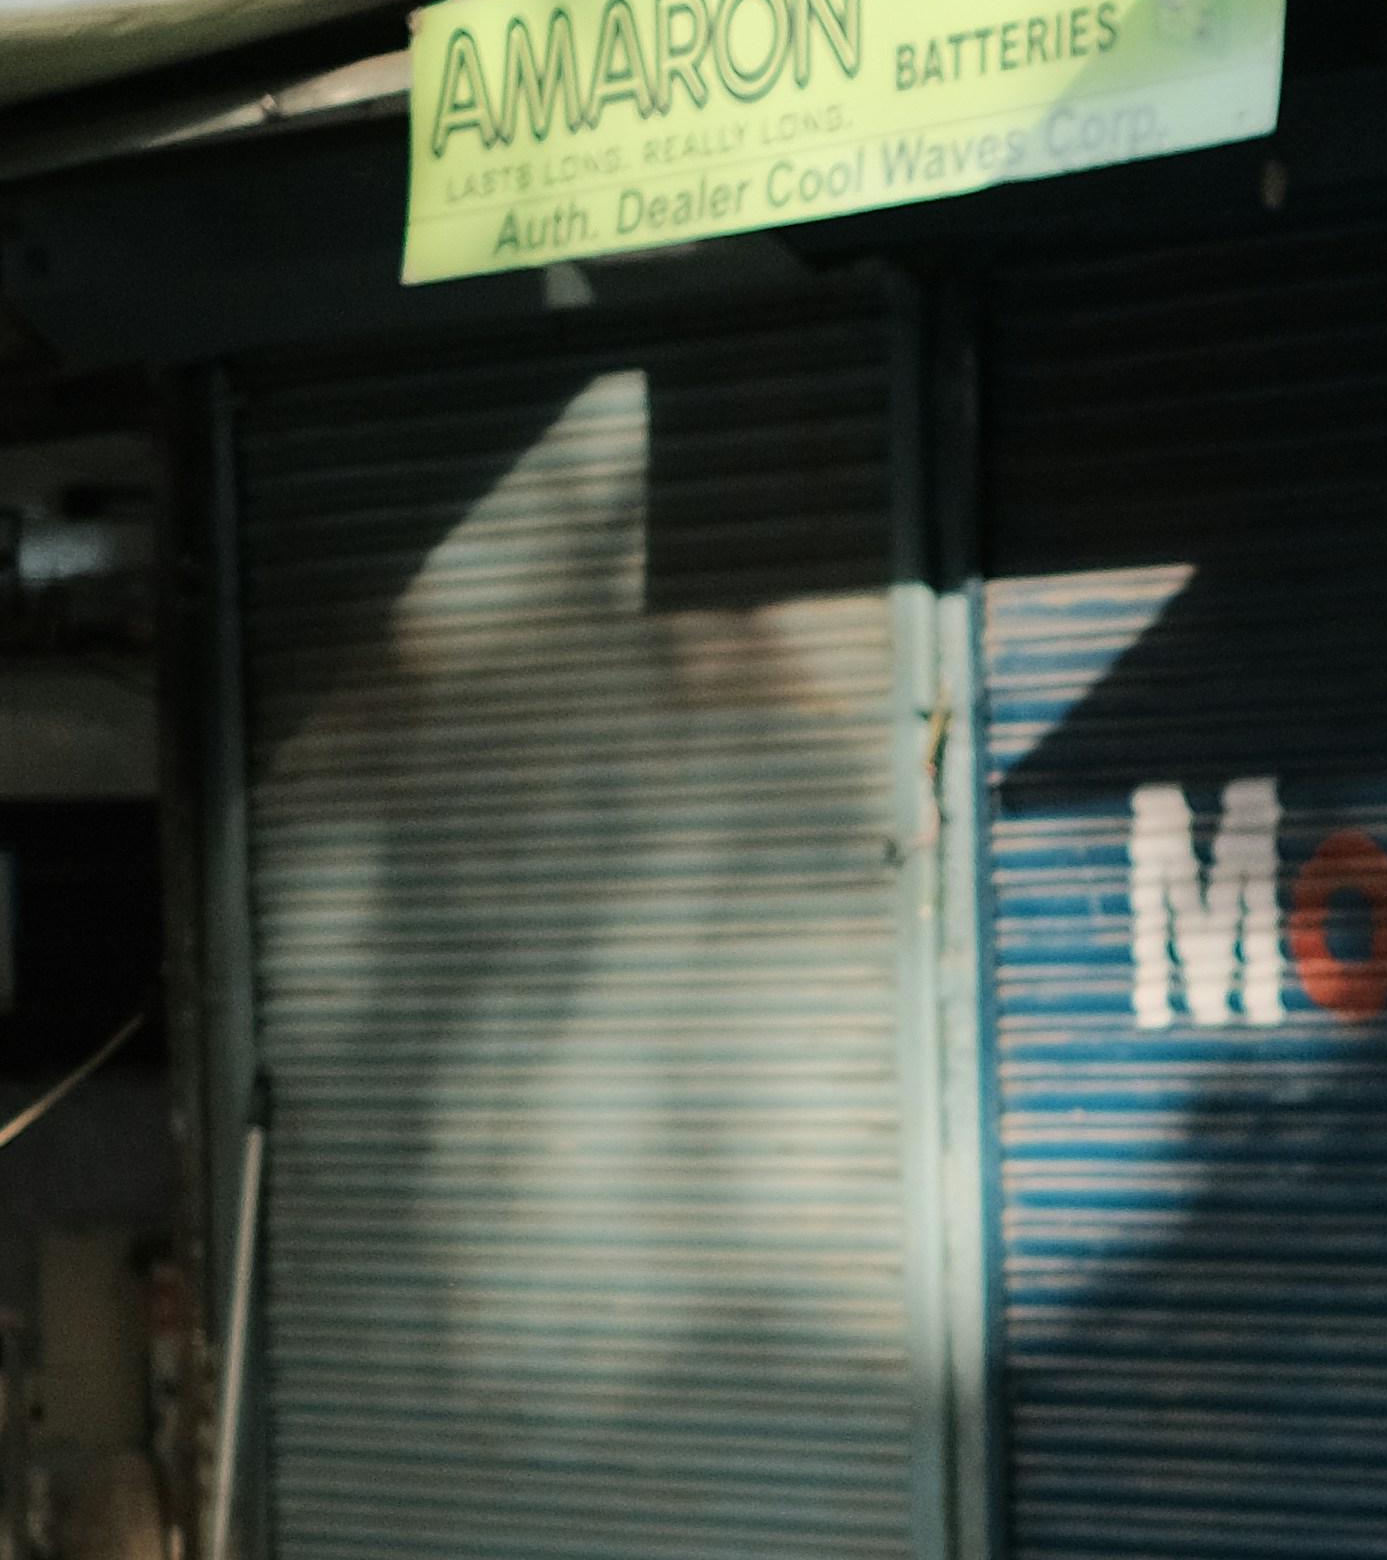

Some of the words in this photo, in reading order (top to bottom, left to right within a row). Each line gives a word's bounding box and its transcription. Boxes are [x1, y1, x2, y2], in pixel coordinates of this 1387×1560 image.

[895, 1, 1119, 91] BATTERIES
[494, 192, 598, 258] Auth.
[616, 175, 750, 236] Dealer
[766, 153, 866, 209] Cool
[882, 122, 1030, 190] Waves
[1043, 103, 1167, 167] Corp.
